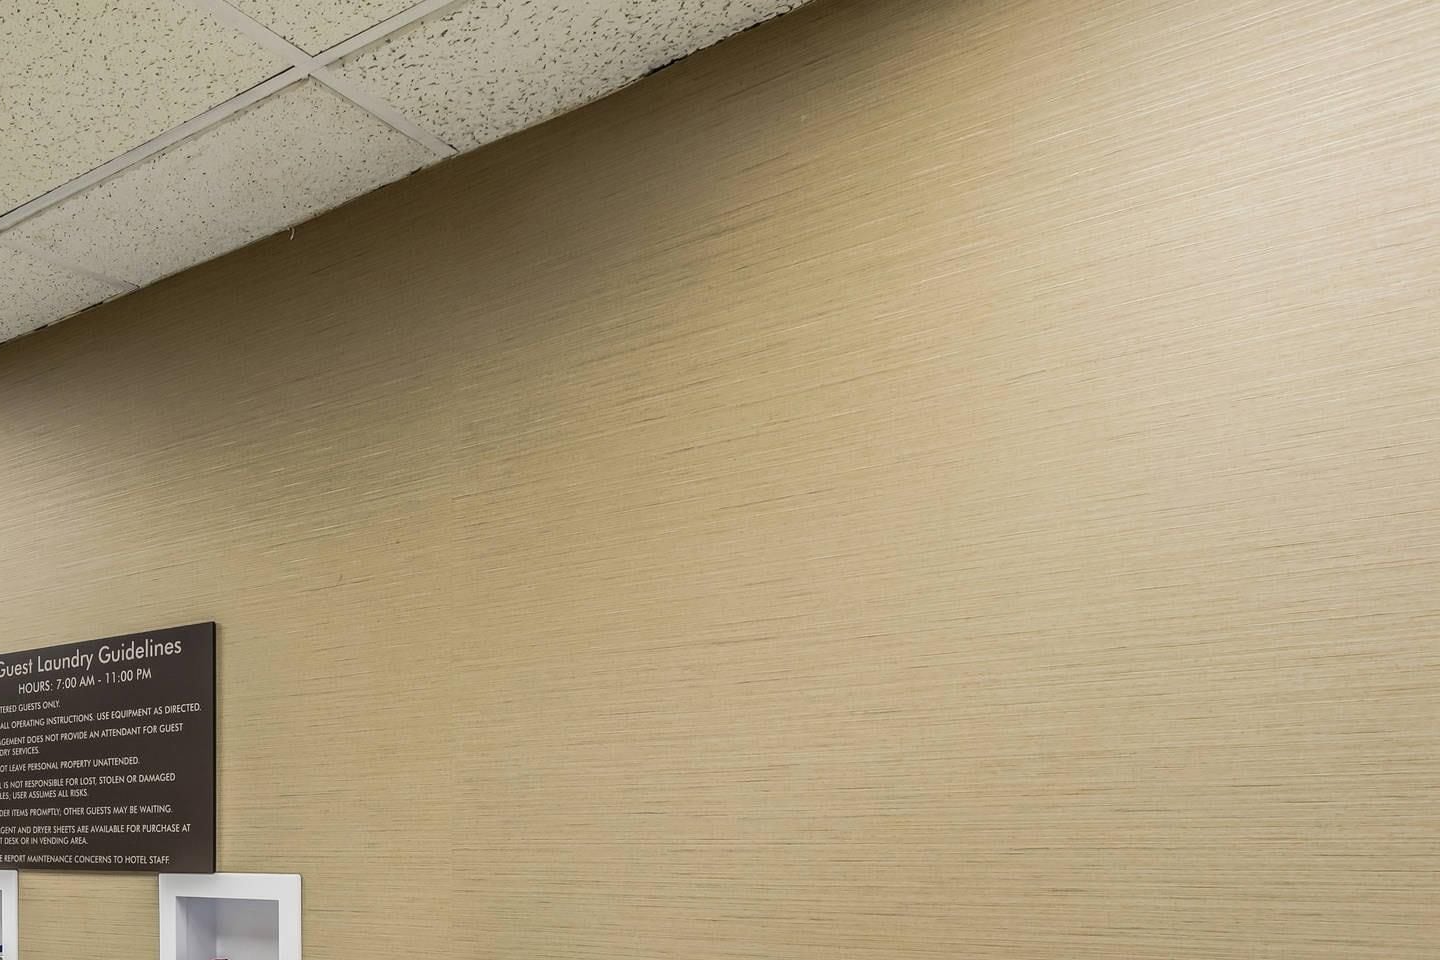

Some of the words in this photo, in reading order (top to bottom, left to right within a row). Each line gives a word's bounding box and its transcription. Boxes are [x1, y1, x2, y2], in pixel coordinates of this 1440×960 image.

[38, 648, 93, 673] Laundry
[99, 639, 182, 664] Guidelines
[19, 680, 53, 694] HOURS:
[56, 677, 76, 690] 7:00
[79, 675, 95, 687] AM
[106, 670, 133, 684] 11:00
[137, 668, 152, 680] PM
[19, 702, 40, 711] GUESTS
[43, 700, 60, 709] ONLY.
[11, 719, 45, 728] OPERATING
[47, 713, 94, 725] INSTRUCTIONS.
[97, 712, 110, 720] USE
[111, 708, 152, 719] EQUIPMENT
[154, 706, 163, 715] AS
[165, 702, 202, 714] DIRECTED.
[27, 735, 43, 744] DOES
[45, 733, 59, 742] NOT
[61, 731, 87, 741] PROVIDE
[89, 730, 100, 738] AN
[101, 727, 141, 737] ATTENDANT
[143, 725, 158, 734] FOR
[160, 723, 183, 733] GUEST
[12, 746, 40, 755] SERVICES.
[9, 764, 26, 772] LEAVE
[28, 762, 59, 771] PERSONAL
[60, 760, 91, 769] PROPERTY
[4, 781, 9, 789] IS
[10, 781, 23, 789] NOT
[25, 779, 63, 788] RESPONSIBLE
[65, 778, 78, 786] FOR
[80, 777, 97, 786] LOST,
[99, 776, 125, 784] STOLEN
[126, 775, 137, 783] OR
[139, 773, 176, 783] DAMAGED
[13, 791, 27, 799] USER
[29, 790, 56, 798] ASSUMES
[86, 807, 111, 815] GUESTS
[113, 806, 128, 814] MAY
[140, 805, 173, 813] WAITING.
[18, 826, 31, 834] AND
[77, 825, 89, 833] ARE
[91, 825, 124, 833] AVAILABLE
[126, 824, 140, 832] FOR
[143, 824, 180, 832] PURCHASE
[182, 824, 191, 832] AT
[70, 837, 88, 845] AREA.
[28, 855, 72, 863] MAINTENANCE
[74, 855, 111, 864] CONCERNS
[114, 856, 123, 864] TO
[125, 856, 147, 864] HOTEL
[149, 856, 170, 864] STAFF.
